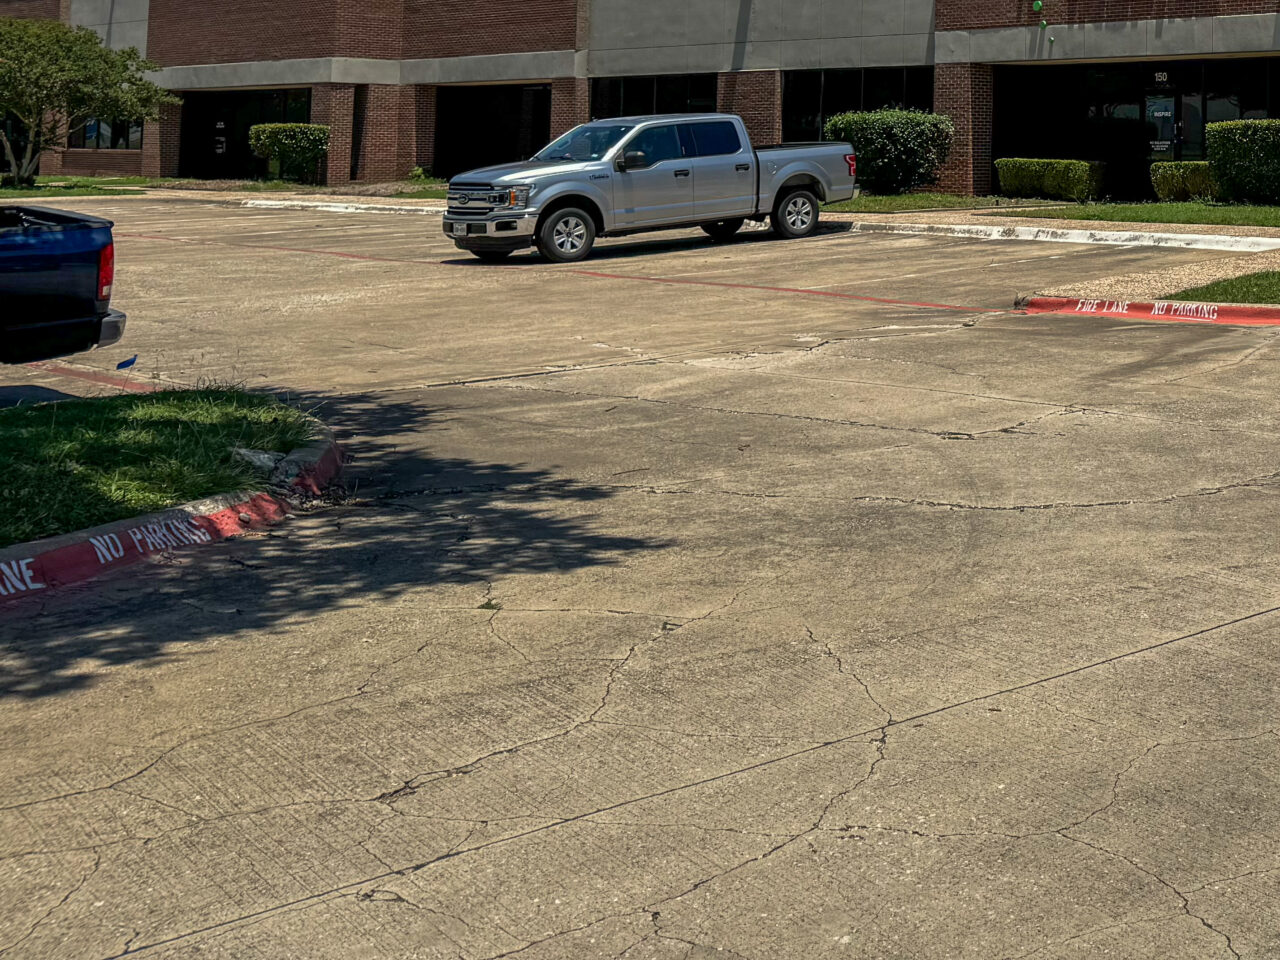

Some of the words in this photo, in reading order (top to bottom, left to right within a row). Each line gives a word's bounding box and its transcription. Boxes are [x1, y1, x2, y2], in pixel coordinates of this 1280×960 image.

[1154, 72, 1168, 82] 150
[1075, 299, 1100, 312] FIRE
[1102, 300, 1131, 313] LANE
[1151, 302, 1167, 315] NO
[1170, 302, 1218, 319] PARKING
[0, 558, 48, 596] NE
[89, 533, 125, 565] NO
[127, 518, 212, 553] PARKING
